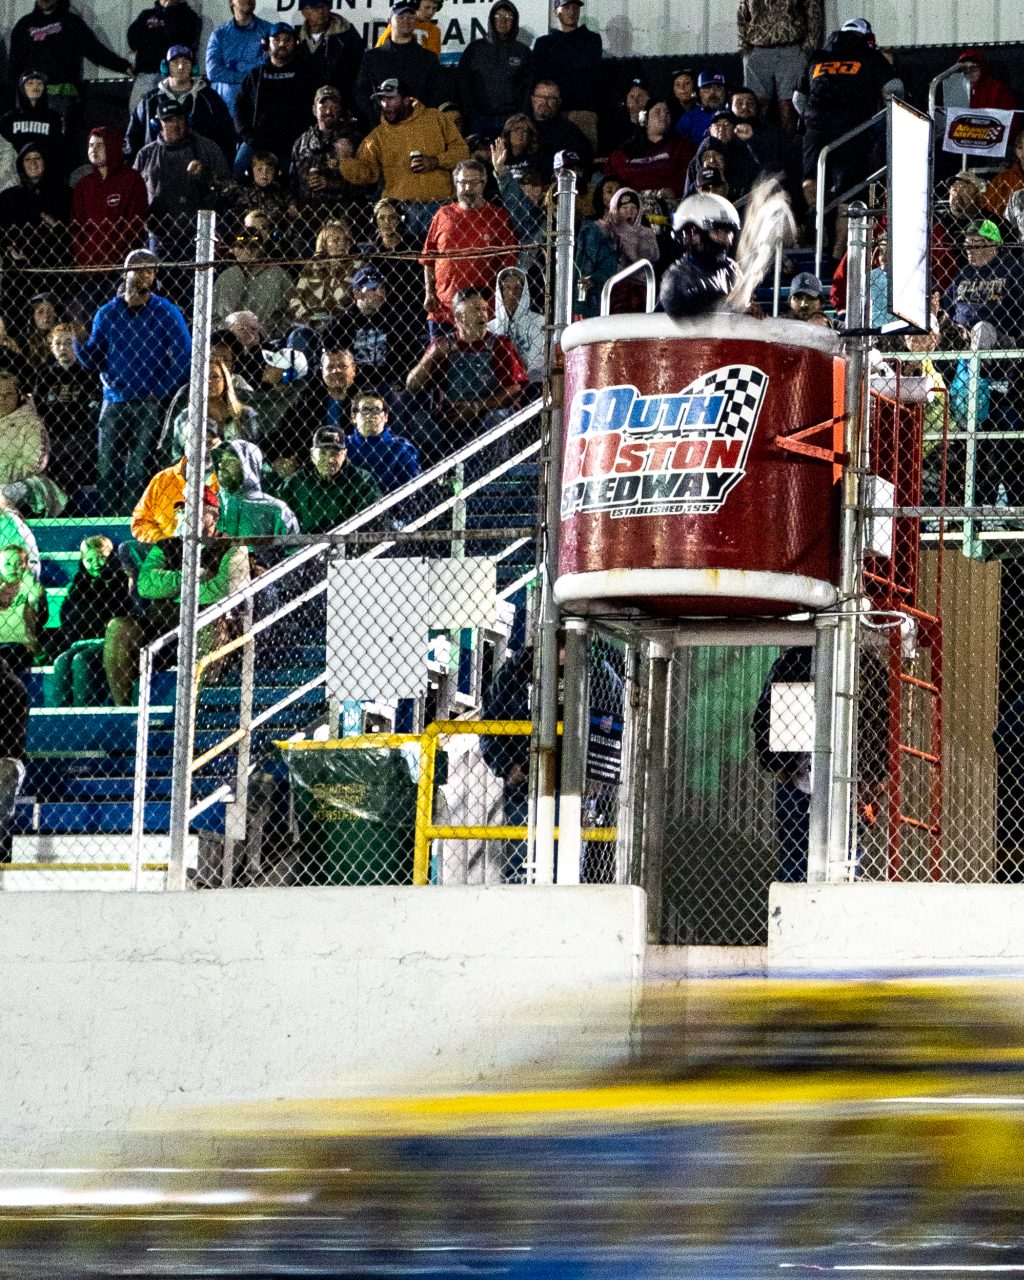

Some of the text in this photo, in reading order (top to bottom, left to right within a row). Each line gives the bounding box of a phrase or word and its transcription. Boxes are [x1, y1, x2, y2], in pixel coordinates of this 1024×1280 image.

[13, 120, 50, 135] PUMA
[570, 387, 727, 437] SOUTH
[565, 432, 744, 484] BOSTON
[562, 471, 735, 512] SPEEDWAY
[612, 503, 719, 517] ESTABLISHED 1957
